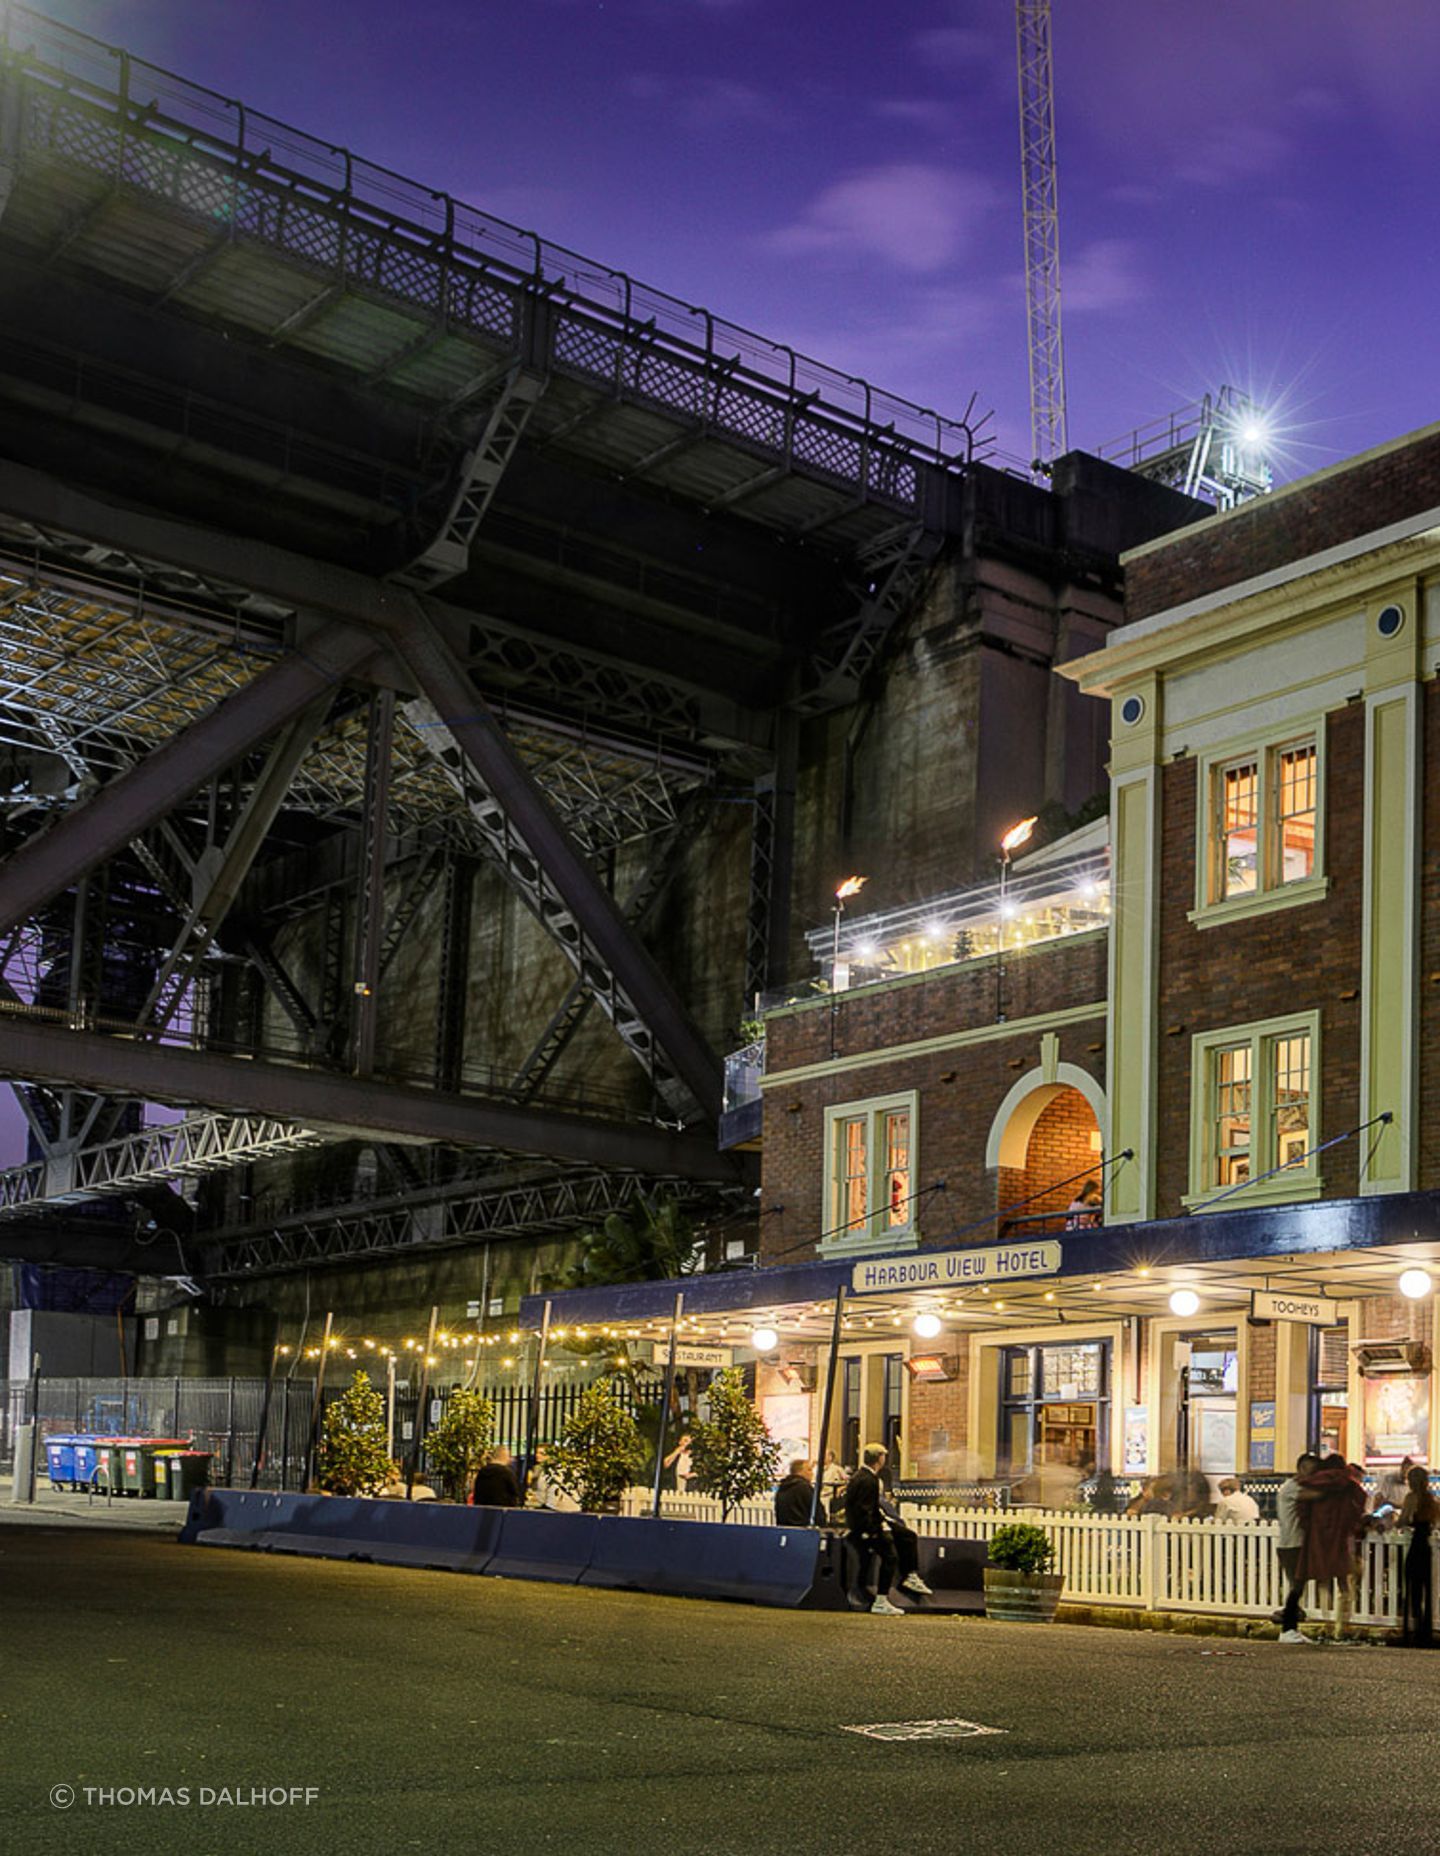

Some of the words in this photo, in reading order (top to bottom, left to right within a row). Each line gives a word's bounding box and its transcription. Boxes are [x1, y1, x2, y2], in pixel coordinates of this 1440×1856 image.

[865, 1261, 939, 1287] HARBOUR
[945, 1256, 986, 1278] VIEW
[996, 1250, 1048, 1273] HOTEL
[1272, 1300, 1320, 1317] TOOHEYS
